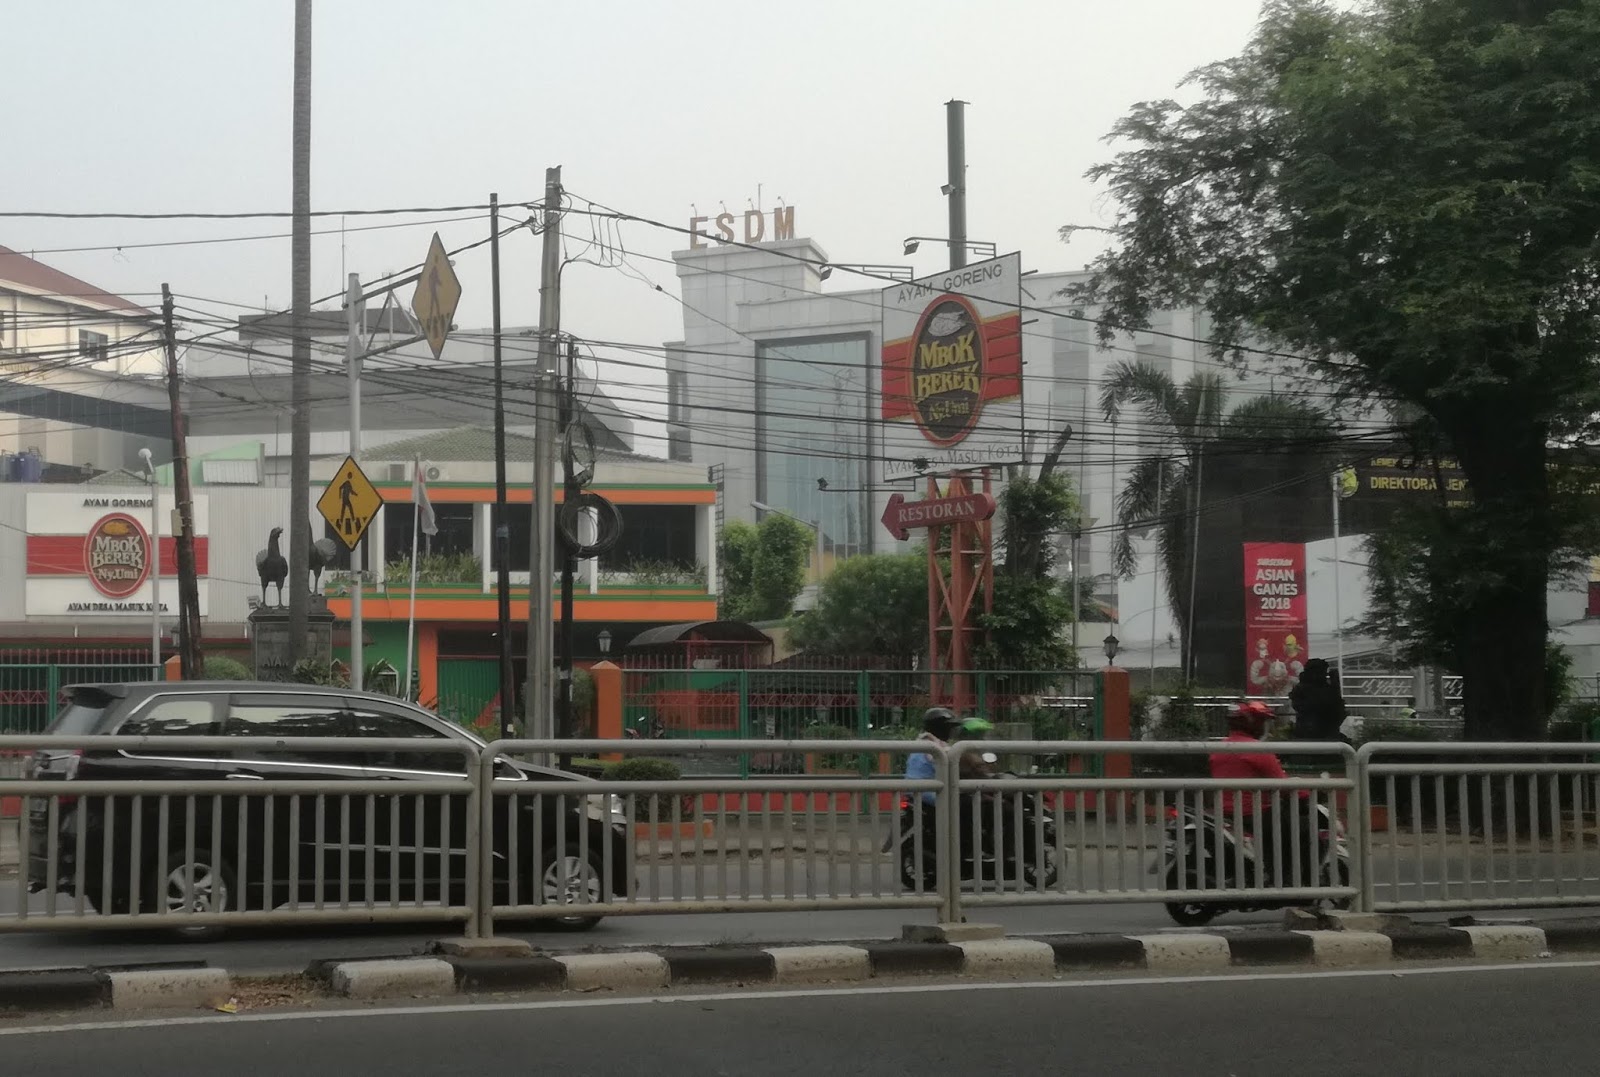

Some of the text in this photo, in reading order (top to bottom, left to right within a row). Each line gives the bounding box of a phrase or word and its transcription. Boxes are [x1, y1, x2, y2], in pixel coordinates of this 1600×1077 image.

[690, 206, 795, 250] ESDM
[898, 264, 1002, 303] AYAM GORENG
[919, 331, 976, 369] MBOK
[1370, 476, 1437, 491] DIREKTORA
[83, 499, 153, 508] AYAM GORENG
[899, 501, 975, 522] RESTORAN
[95, 536, 141, 552] MBOK
[92, 551, 143, 570] BEREK
[97, 569, 138, 581] Ny.Umi
[1256, 569, 1294, 581] ASIAN
[1253, 583, 1297, 595] GAMES
[67, 603, 168, 612] AYAM DESA MASUK KTA
[1261, 598, 1290, 609] 2018
